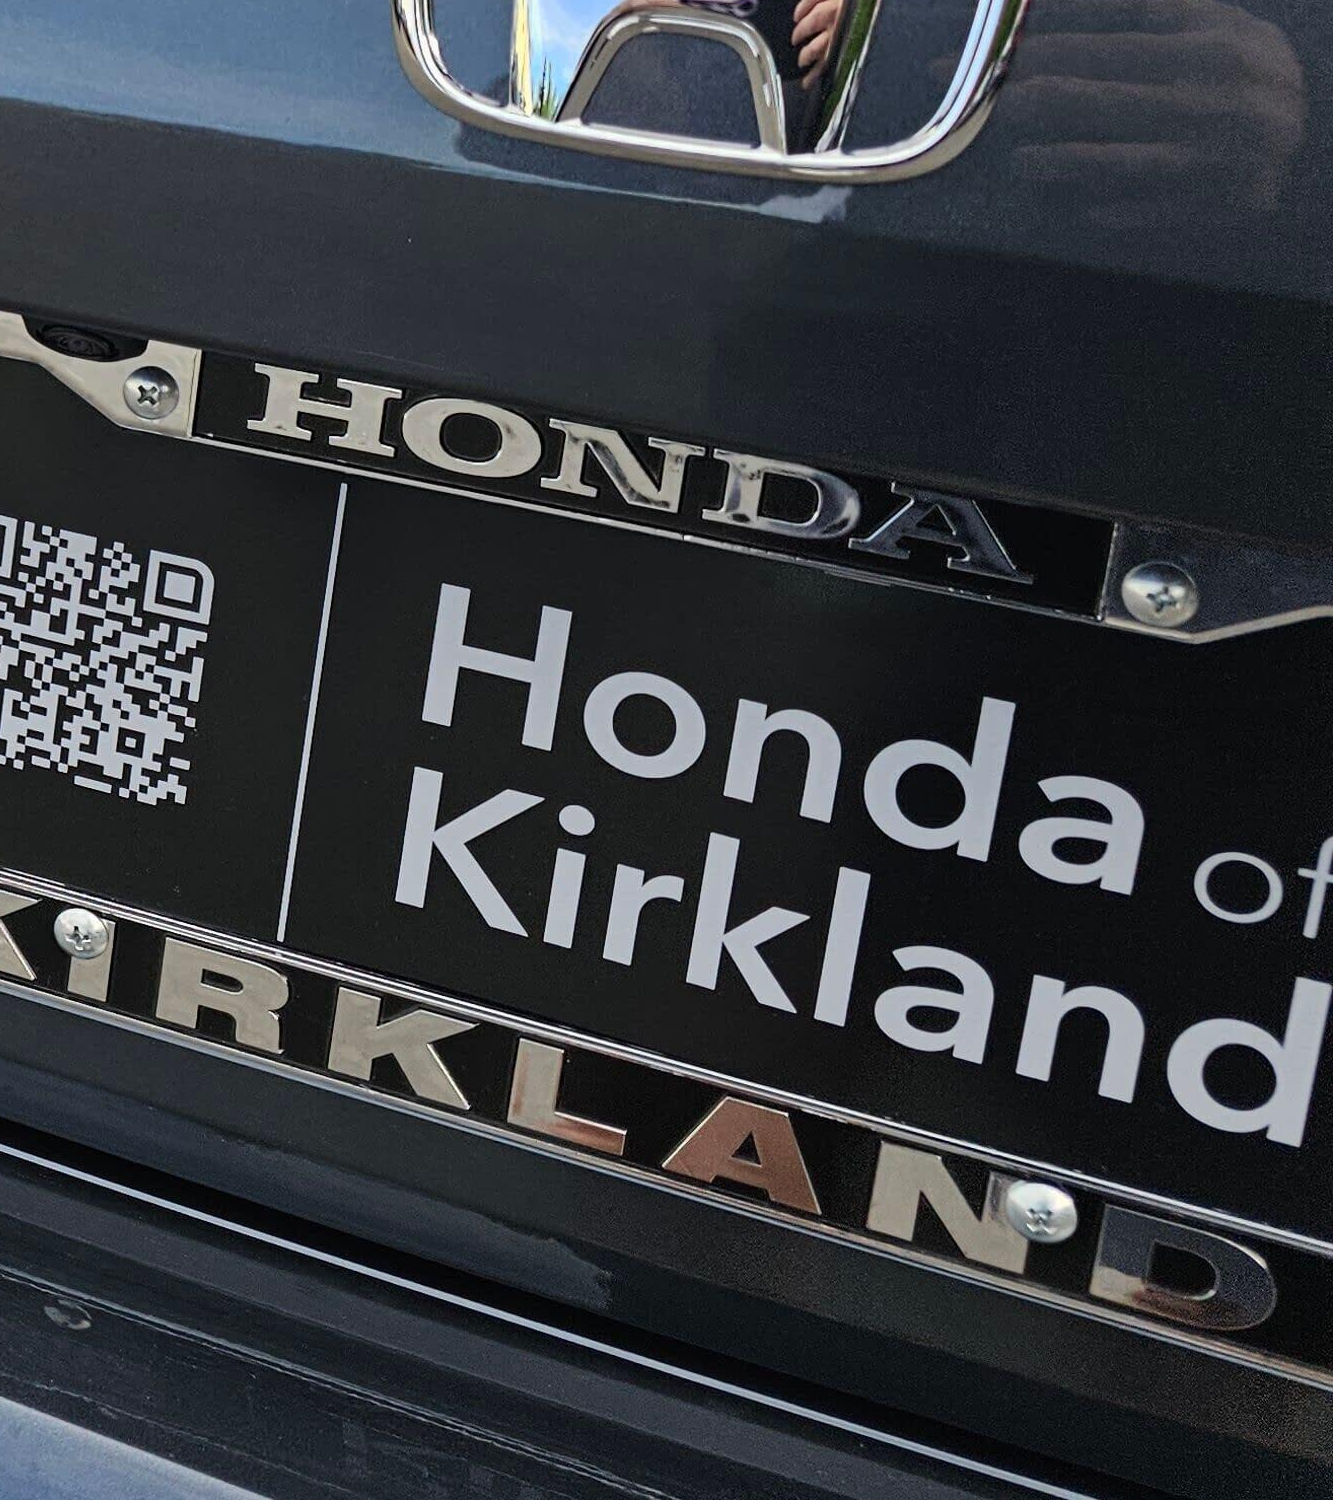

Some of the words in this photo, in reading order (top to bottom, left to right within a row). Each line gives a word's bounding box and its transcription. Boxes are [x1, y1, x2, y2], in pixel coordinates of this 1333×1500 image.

[245, 362, 1035, 587] HONDA
[420, 583, 1145, 898] Honda
[1192, 835, 1333, 940] of
[394, 765, 1332, 1149] Kirkland
